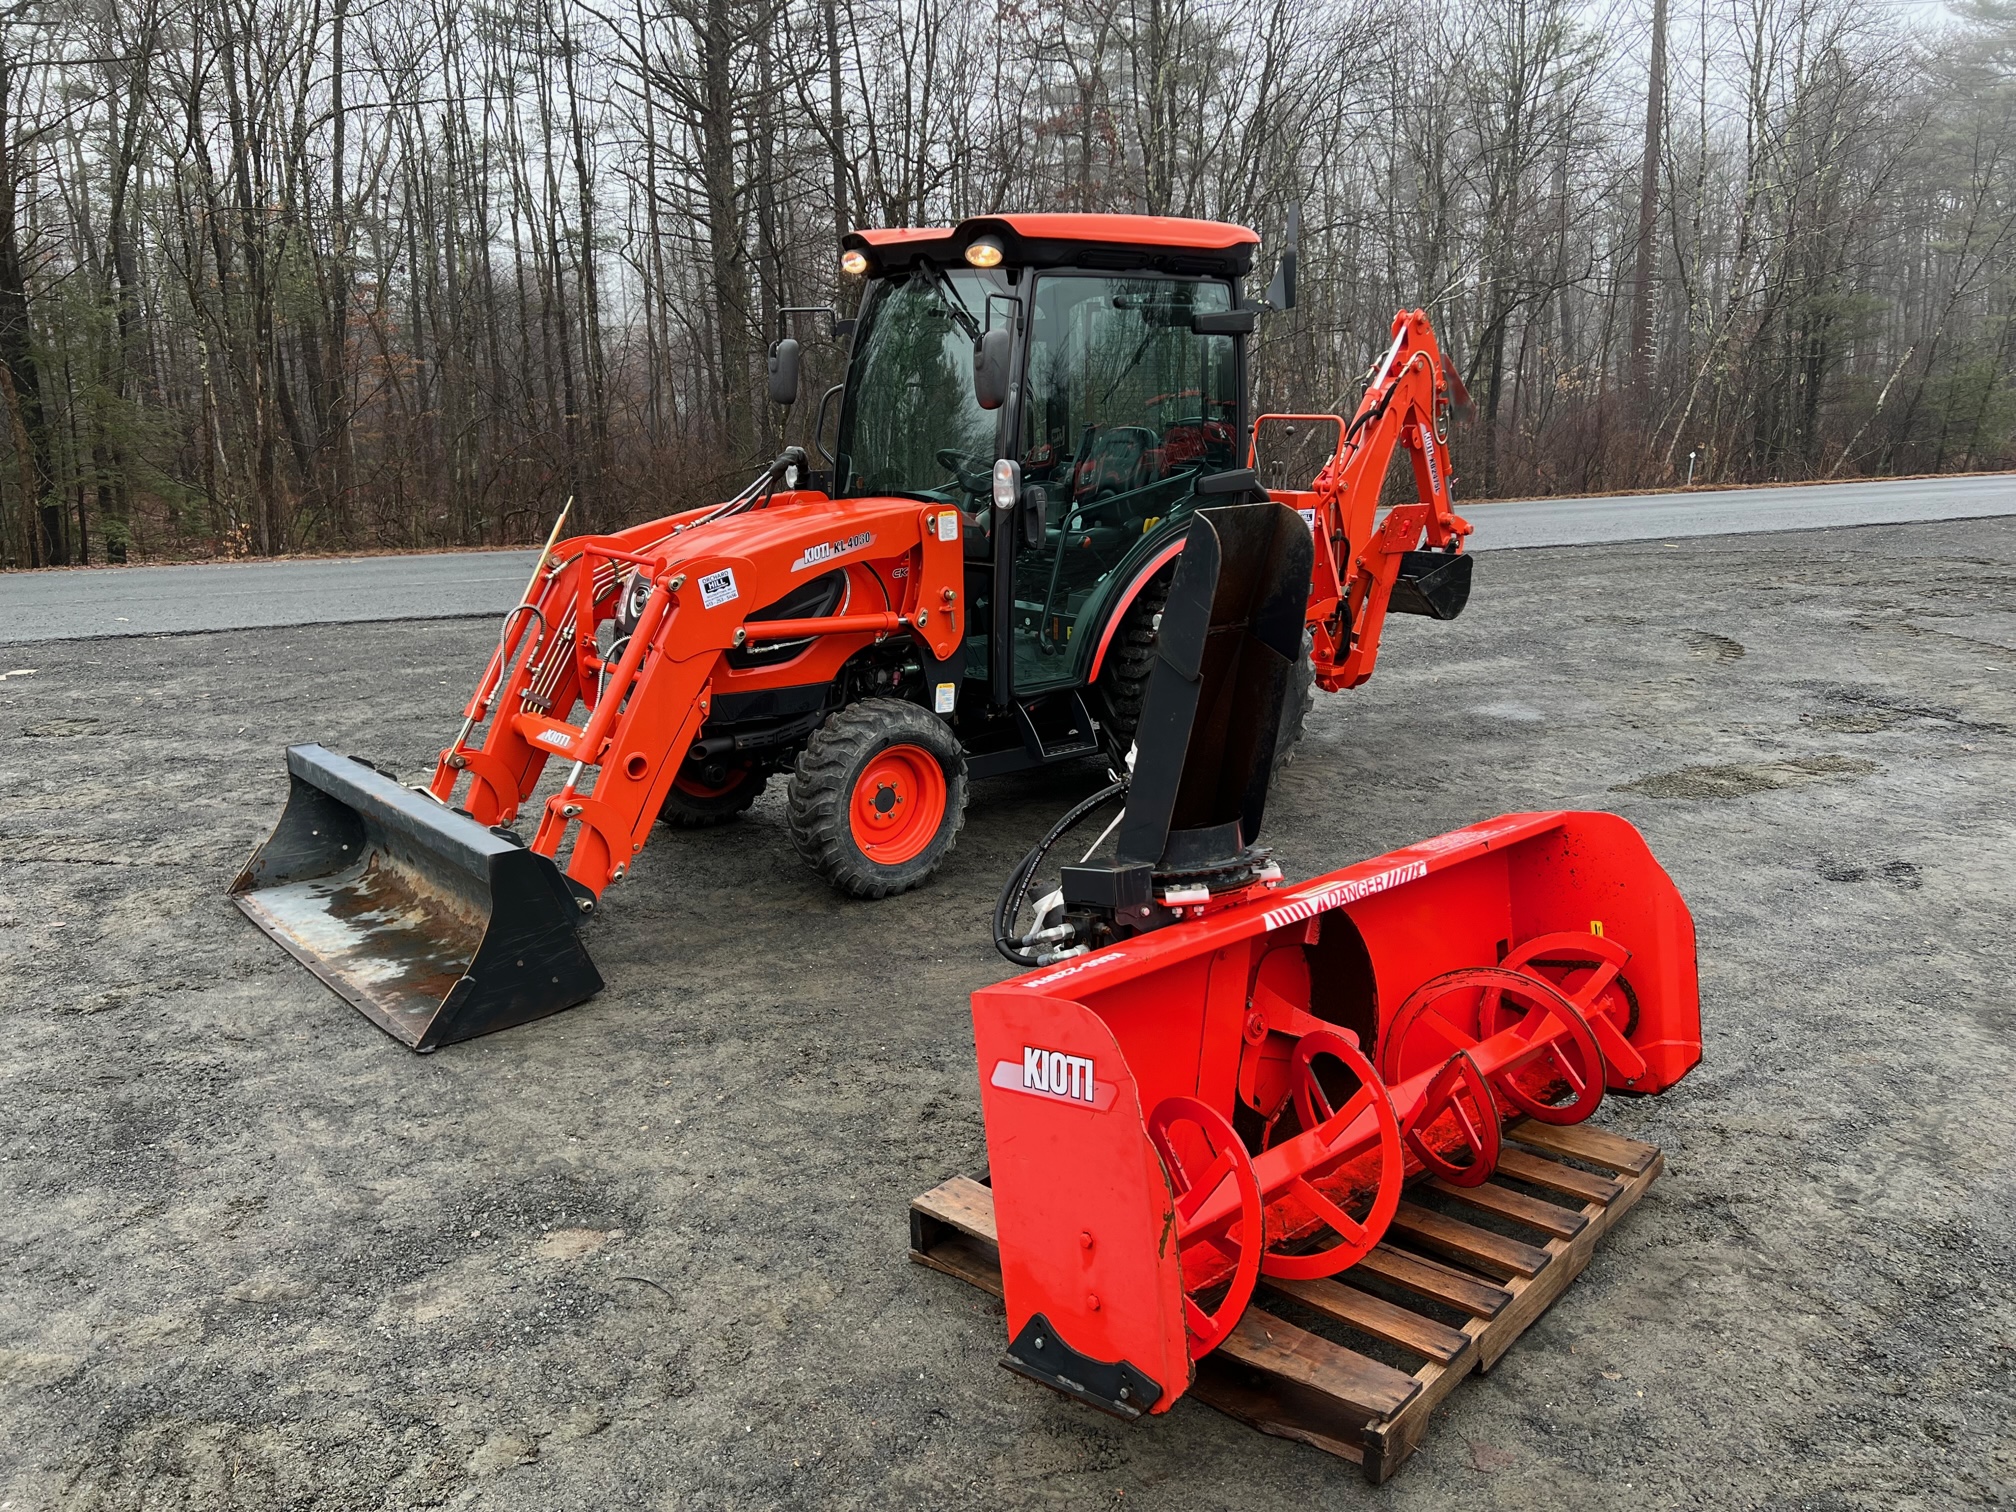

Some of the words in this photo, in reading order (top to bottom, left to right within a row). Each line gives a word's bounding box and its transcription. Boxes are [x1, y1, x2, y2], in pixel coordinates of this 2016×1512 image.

[1424, 431, 1435, 456] KIOTI
[804, 542, 830, 564] KIOTI
[702, 571, 728, 583] ORCHARD
[708, 579, 726, 589] HILL
[544, 728, 571, 747] KIOTI
[1327, 876, 1385, 908] DANGER
[1023, 1046, 1095, 1103] KIOTI
